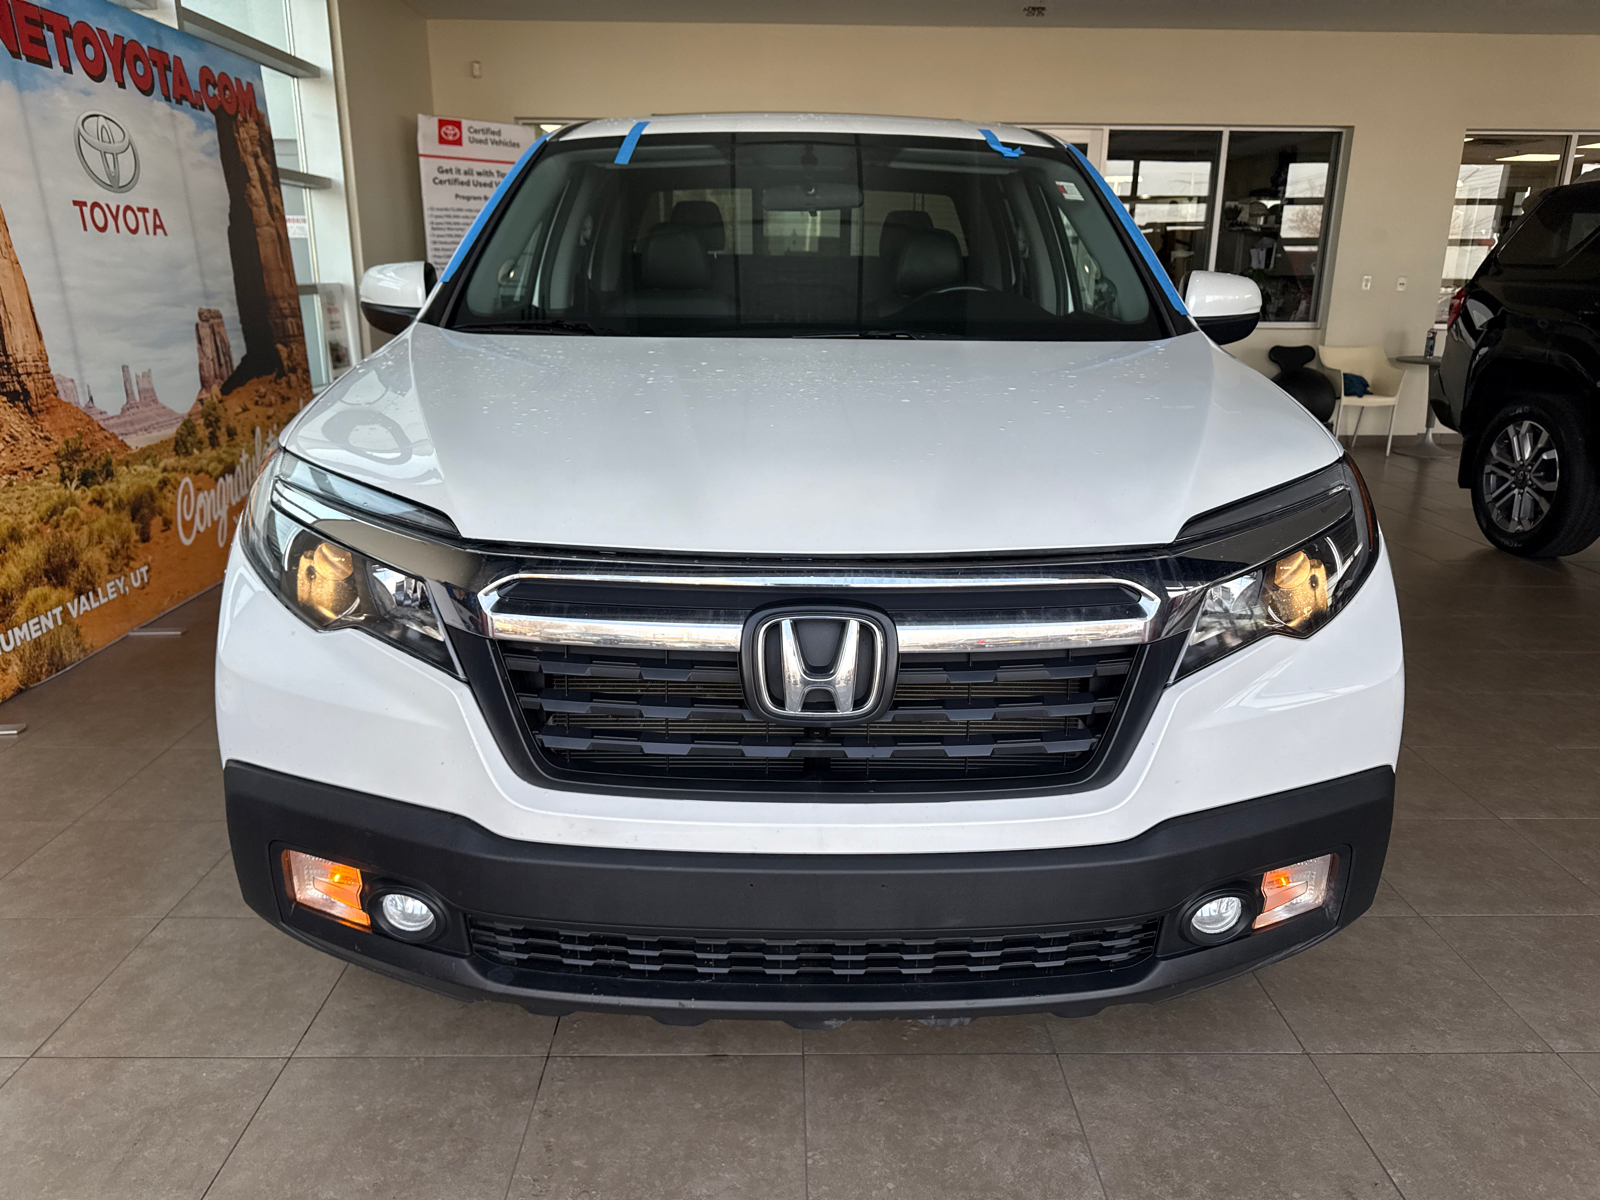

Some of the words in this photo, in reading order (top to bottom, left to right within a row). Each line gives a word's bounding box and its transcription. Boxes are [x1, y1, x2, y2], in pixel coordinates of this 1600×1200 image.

[467, 125, 502, 137] Certified
[468, 136, 489, 145] Used
[490, 137, 520, 149] Vehicles
[437, 165, 453, 175] Get
[455, 166, 461, 175] it
[463, 167, 474, 176] all
[476, 169, 494, 177] with
[432, 177, 471, 187] Certified
[472, 180, 493, 188] Used
[455, 193, 482, 202] Program
[72, 199, 168, 237] TOYOTA
[0, 606, 63, 656] UMENT
[66, 577, 130, 619] VALLEY,
[130, 564, 150, 590] UT
